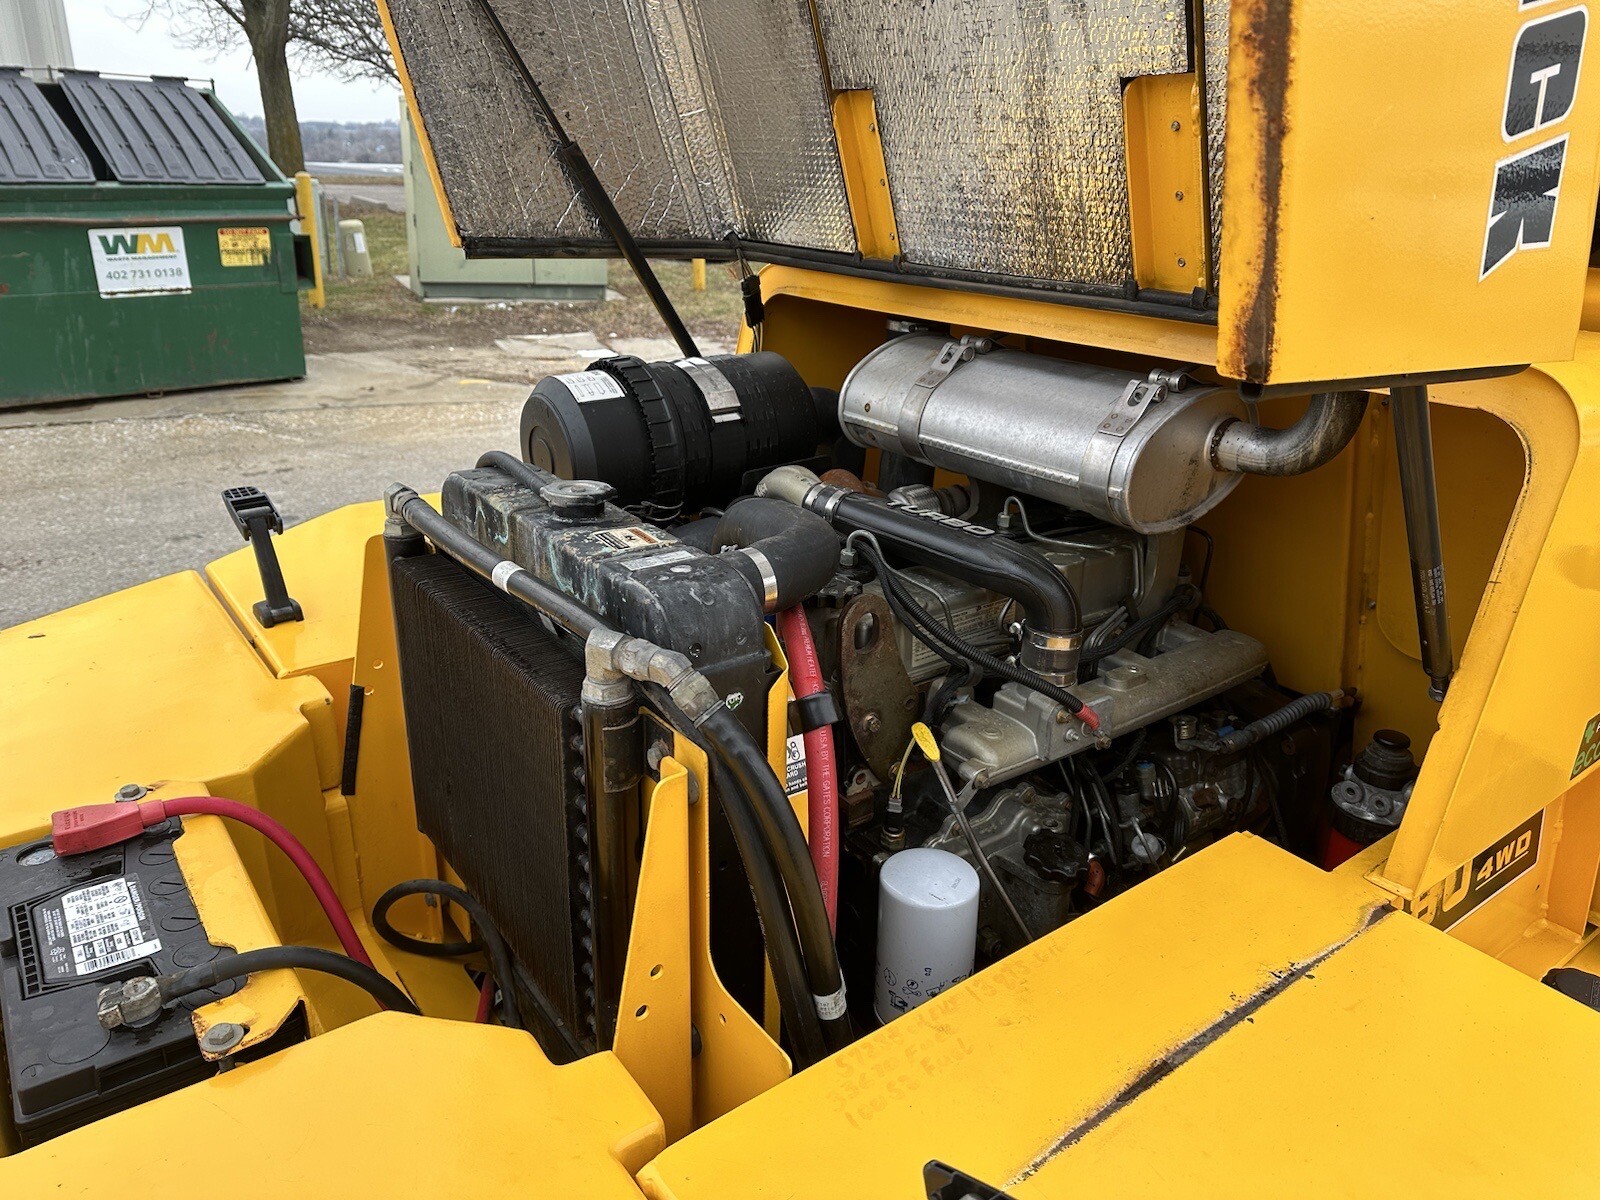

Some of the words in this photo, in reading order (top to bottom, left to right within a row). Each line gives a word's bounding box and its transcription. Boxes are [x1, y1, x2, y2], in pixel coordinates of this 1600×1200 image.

[1478, 0, 1589, 283] CK
[97, 233, 176, 255] WM
[106, 270, 128, 280] 402
[130, 269, 151, 279] 731
[154, 267, 183, 278] 0138
[886, 499, 996, 536] TURBO
[820, 730, 828, 748] USA
[821, 750, 829, 761] BY
[822, 763, 831, 778] THE
[822, 780, 831, 805] GATES
[822, 806, 832, 858] CORPORATION
[1475, 829, 1532, 881] 4WD
